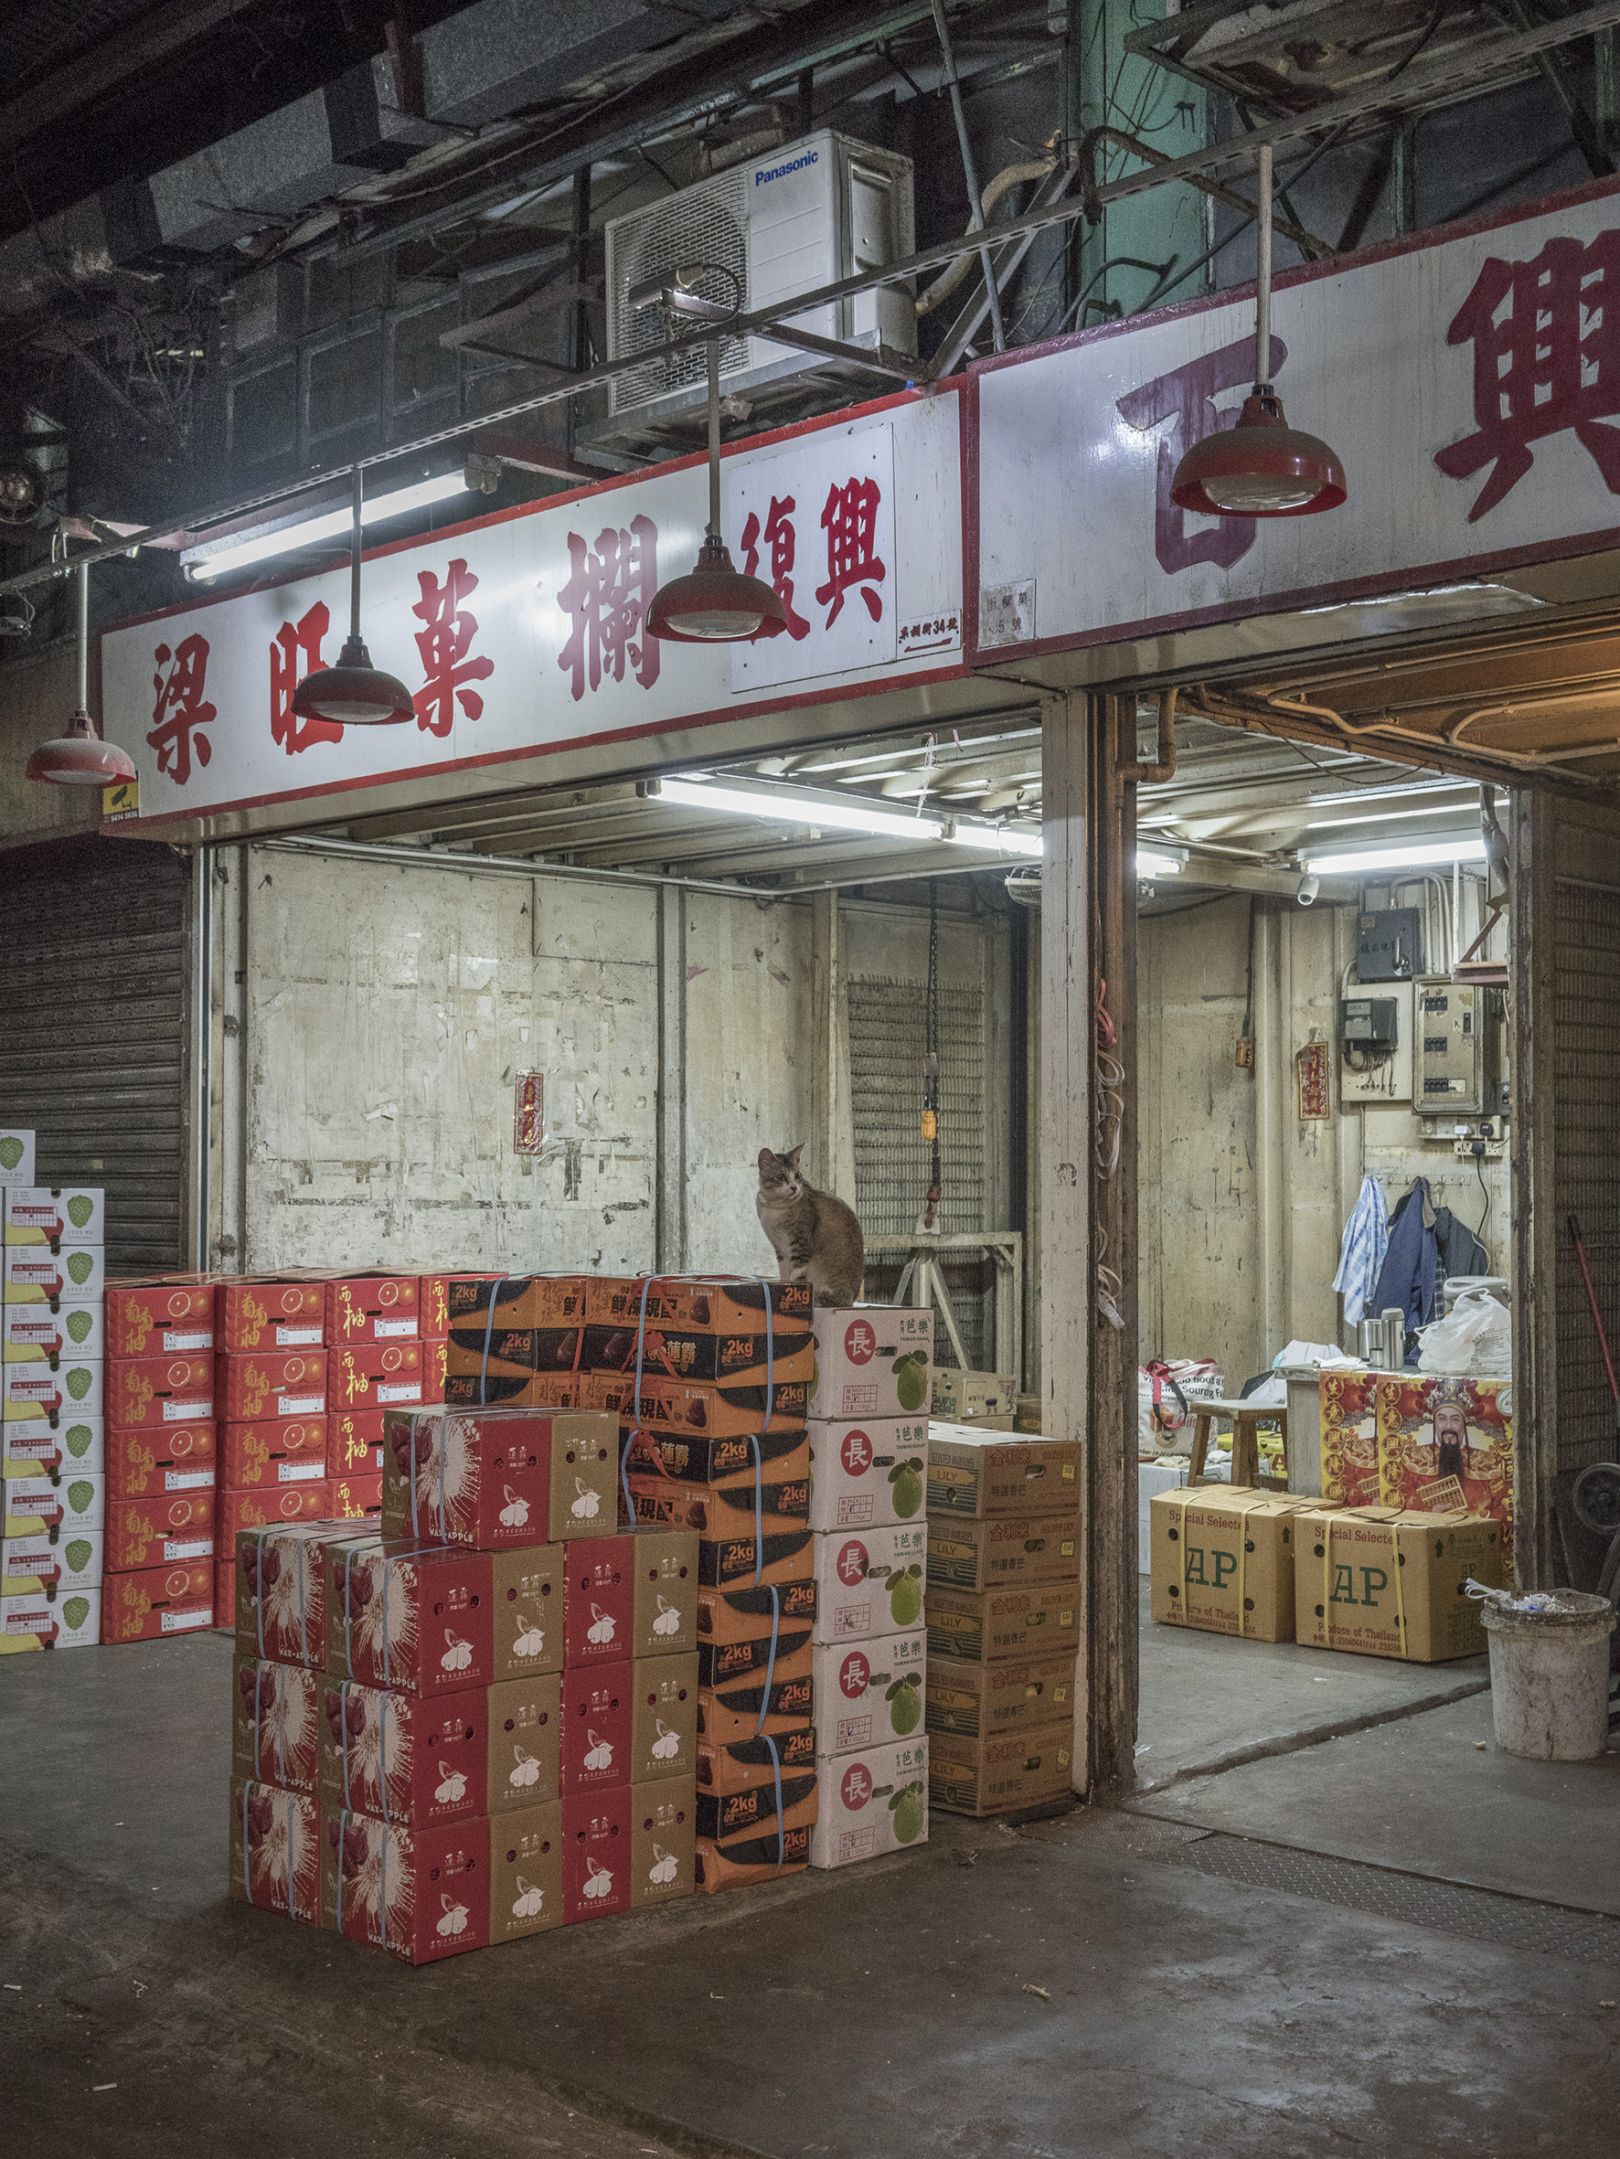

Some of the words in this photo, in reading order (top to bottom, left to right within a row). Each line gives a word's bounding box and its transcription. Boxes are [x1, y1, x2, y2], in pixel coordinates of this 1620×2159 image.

[755, 151, 819, 187] Panasonic
[848, 1327, 872, 1357] 長
[845, 1438, 869, 1468] 長
[937, 1470, 958, 1482] LILY
[1169, 1510, 1204, 1524] Spcial
[841, 1548, 863, 1578] 長
[1185, 1547, 1237, 1589] AP
[1329, 1564, 1388, 1607] AP
[843, 1660, 866, 1691] 長
[845, 1771, 869, 1803] 長
